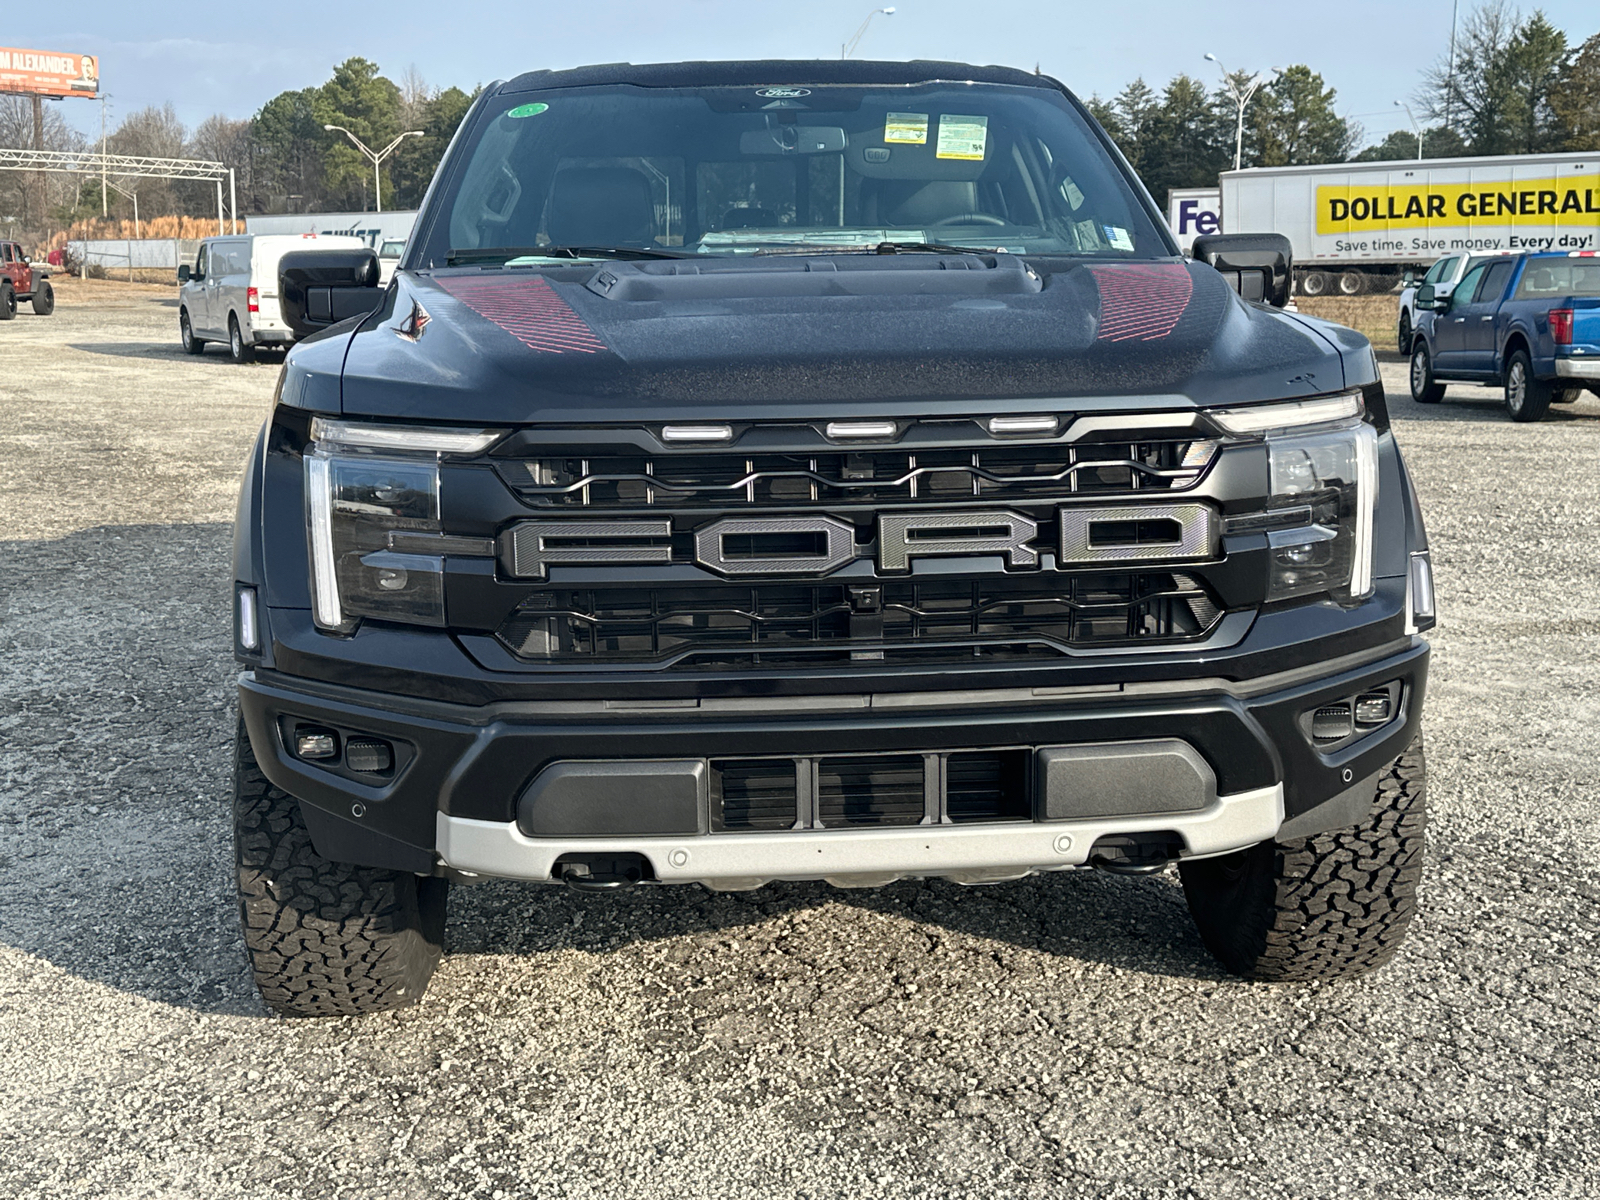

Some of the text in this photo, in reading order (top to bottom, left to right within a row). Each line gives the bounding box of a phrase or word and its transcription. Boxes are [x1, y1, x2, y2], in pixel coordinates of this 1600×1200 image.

[12, 52, 78, 75] ALEXANDER.
[763, 87, 803, 97] Ford
[1179, 200, 1221, 235] Fe
[1329, 189, 1600, 221] DOLLAR GENERAL
[1335, 234, 1593, 252] Save time. Save money. Every day!
[502, 502, 1216, 579] FORD
